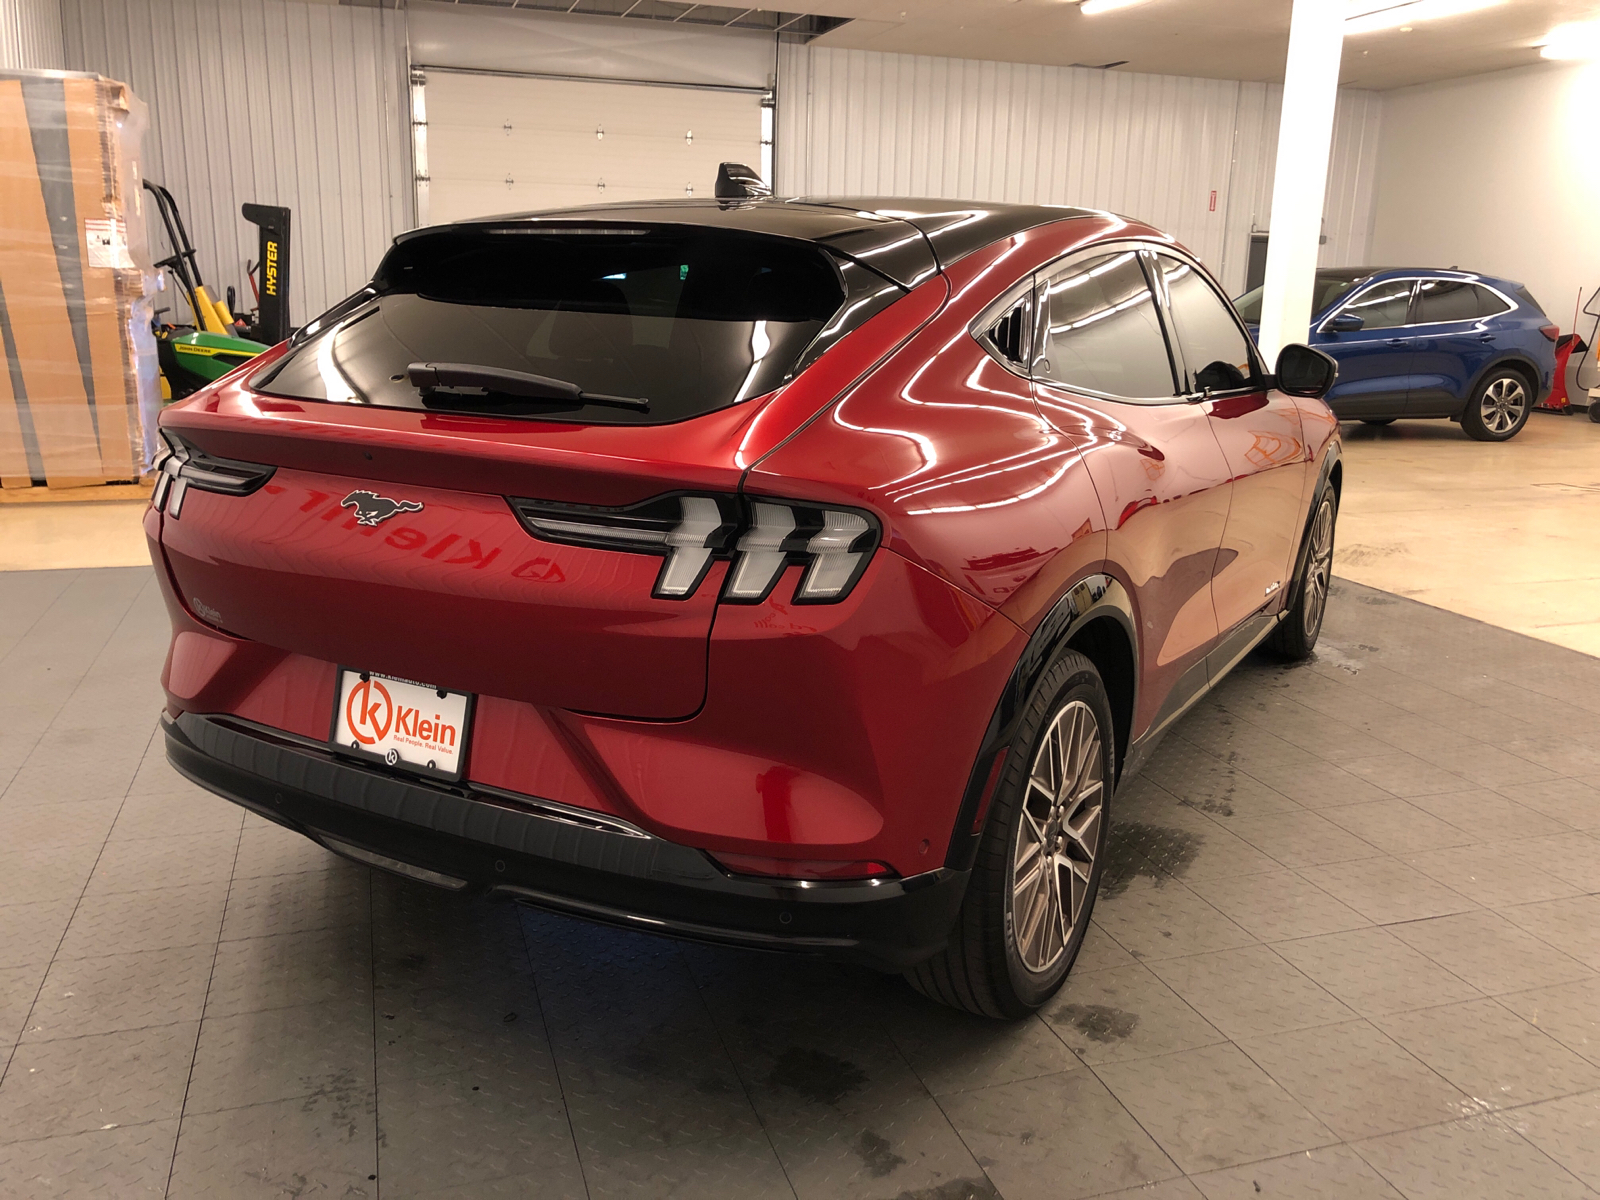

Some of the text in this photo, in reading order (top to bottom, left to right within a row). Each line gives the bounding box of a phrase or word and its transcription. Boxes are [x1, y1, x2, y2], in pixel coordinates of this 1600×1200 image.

[266, 240, 278, 296] HYSTER
[393, 734, 454, 755] Real People. Real Value.
[395, 705, 456, 747] Klein
